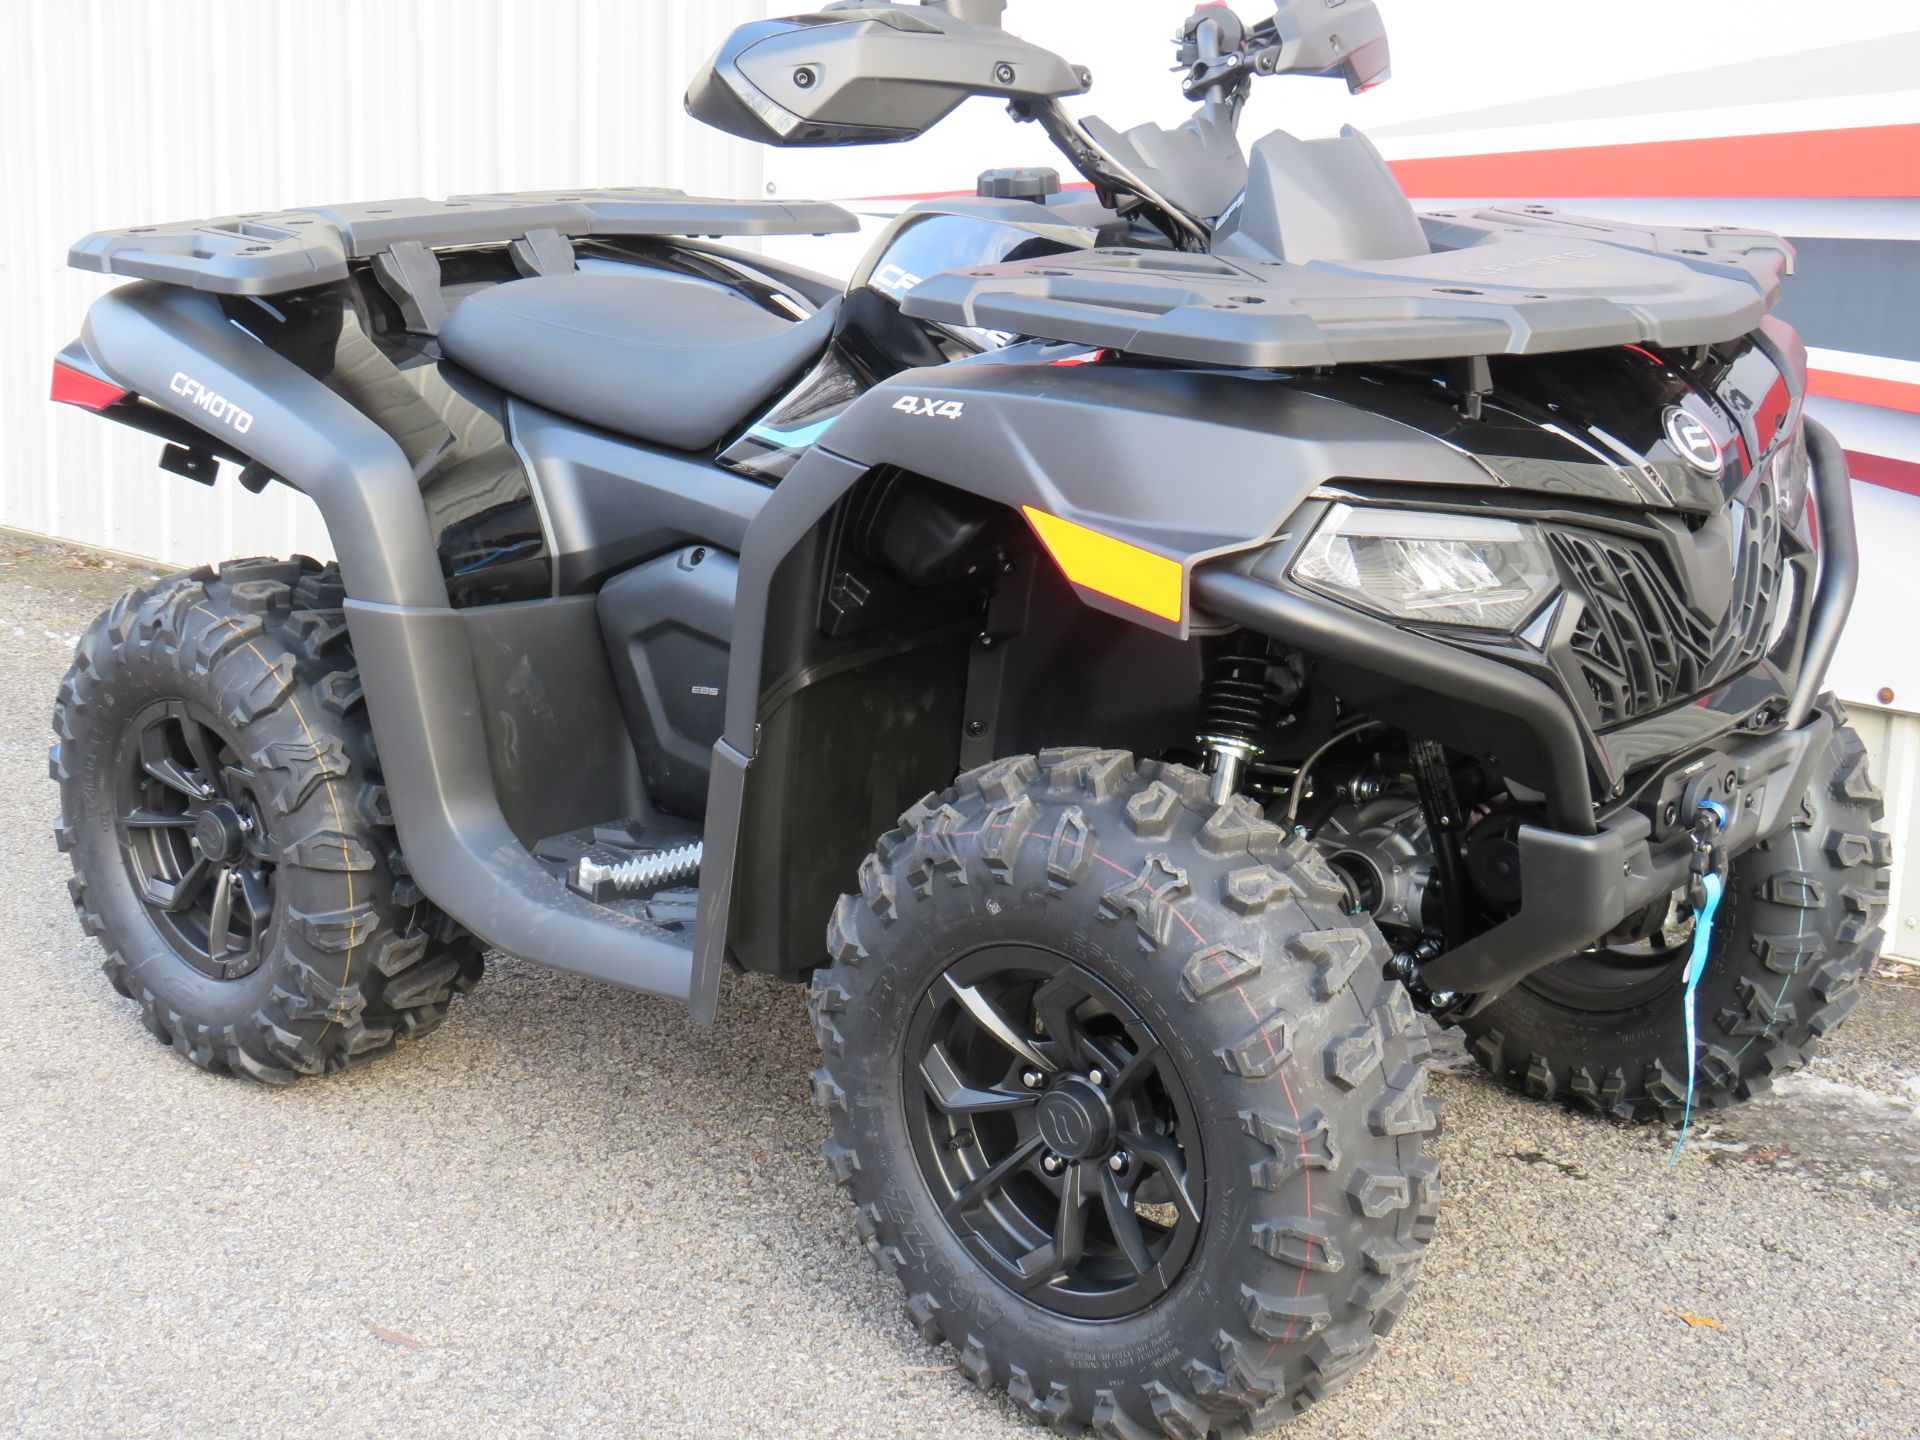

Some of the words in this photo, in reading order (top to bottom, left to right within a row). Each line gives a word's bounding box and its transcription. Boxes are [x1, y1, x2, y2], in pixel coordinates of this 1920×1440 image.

[169, 371, 254, 434] CFMOTO
[892, 395, 965, 420] 4X4
[691, 685, 719, 696] EBS
